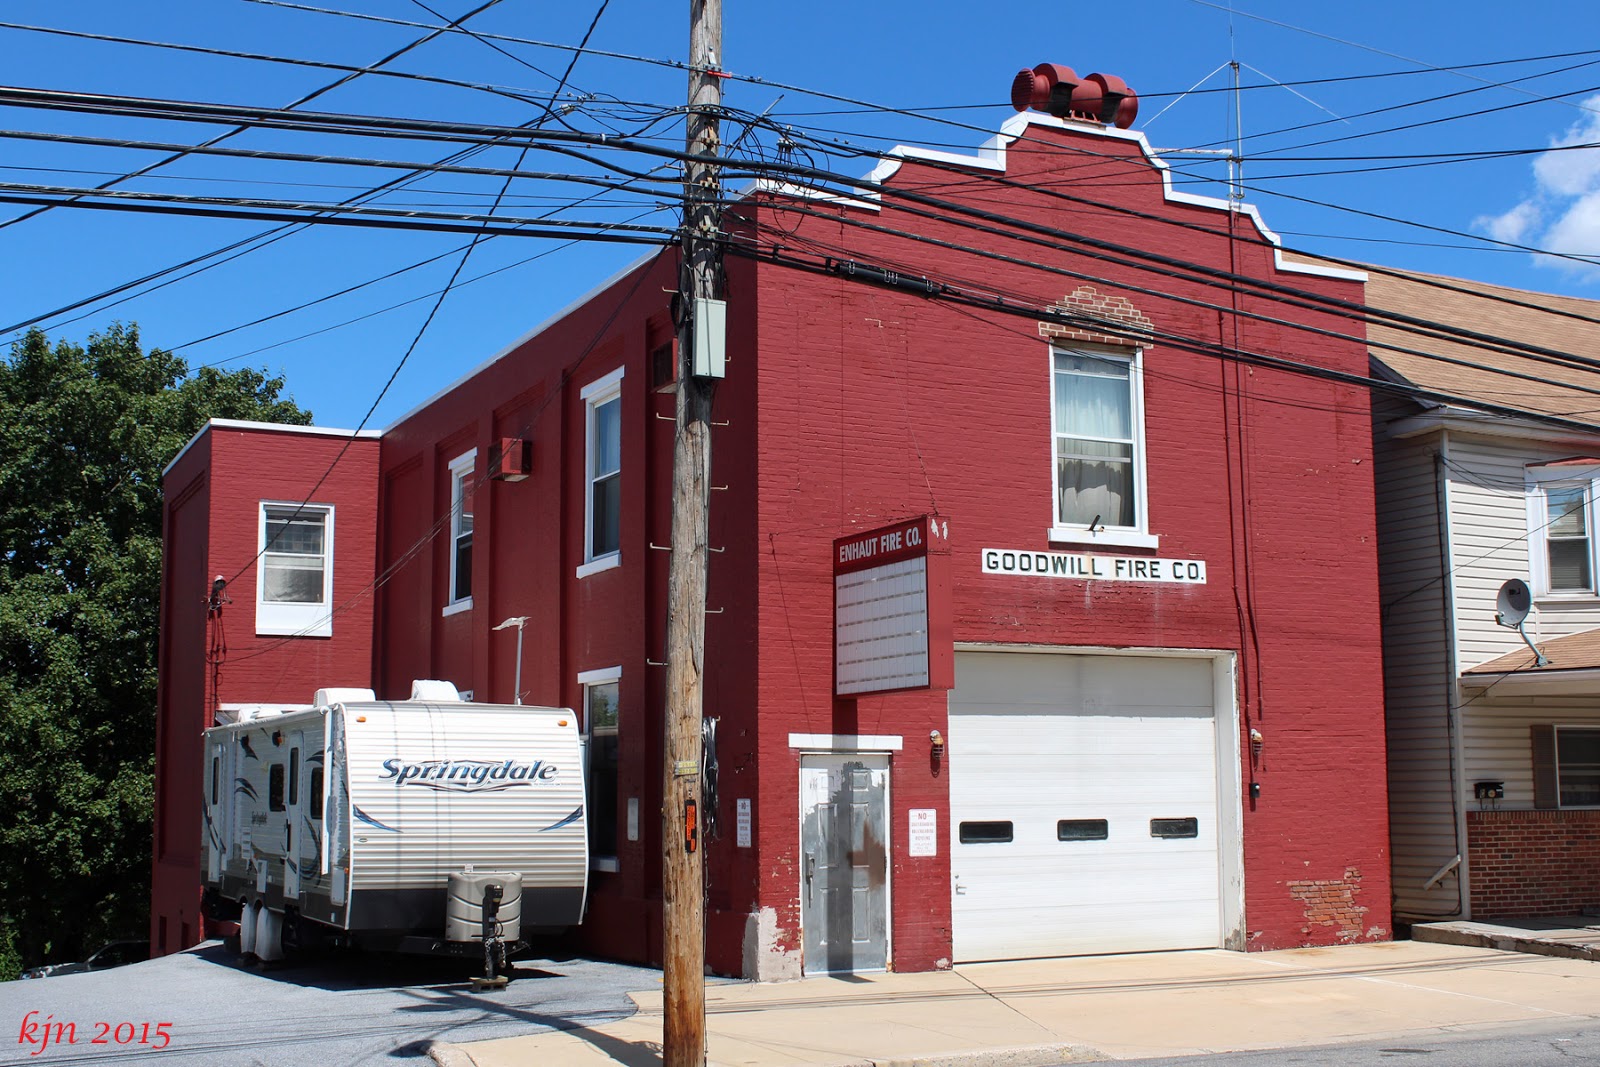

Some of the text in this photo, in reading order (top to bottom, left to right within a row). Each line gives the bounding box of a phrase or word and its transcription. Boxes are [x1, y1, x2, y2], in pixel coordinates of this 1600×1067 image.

[839, 526, 922, 563] ENHAUT FIRE CO.
[986, 551, 1205, 580] GOODWILL FIRE CO.
[378, 758, 559, 788] Springdale
[917, 812, 928, 820] NO
